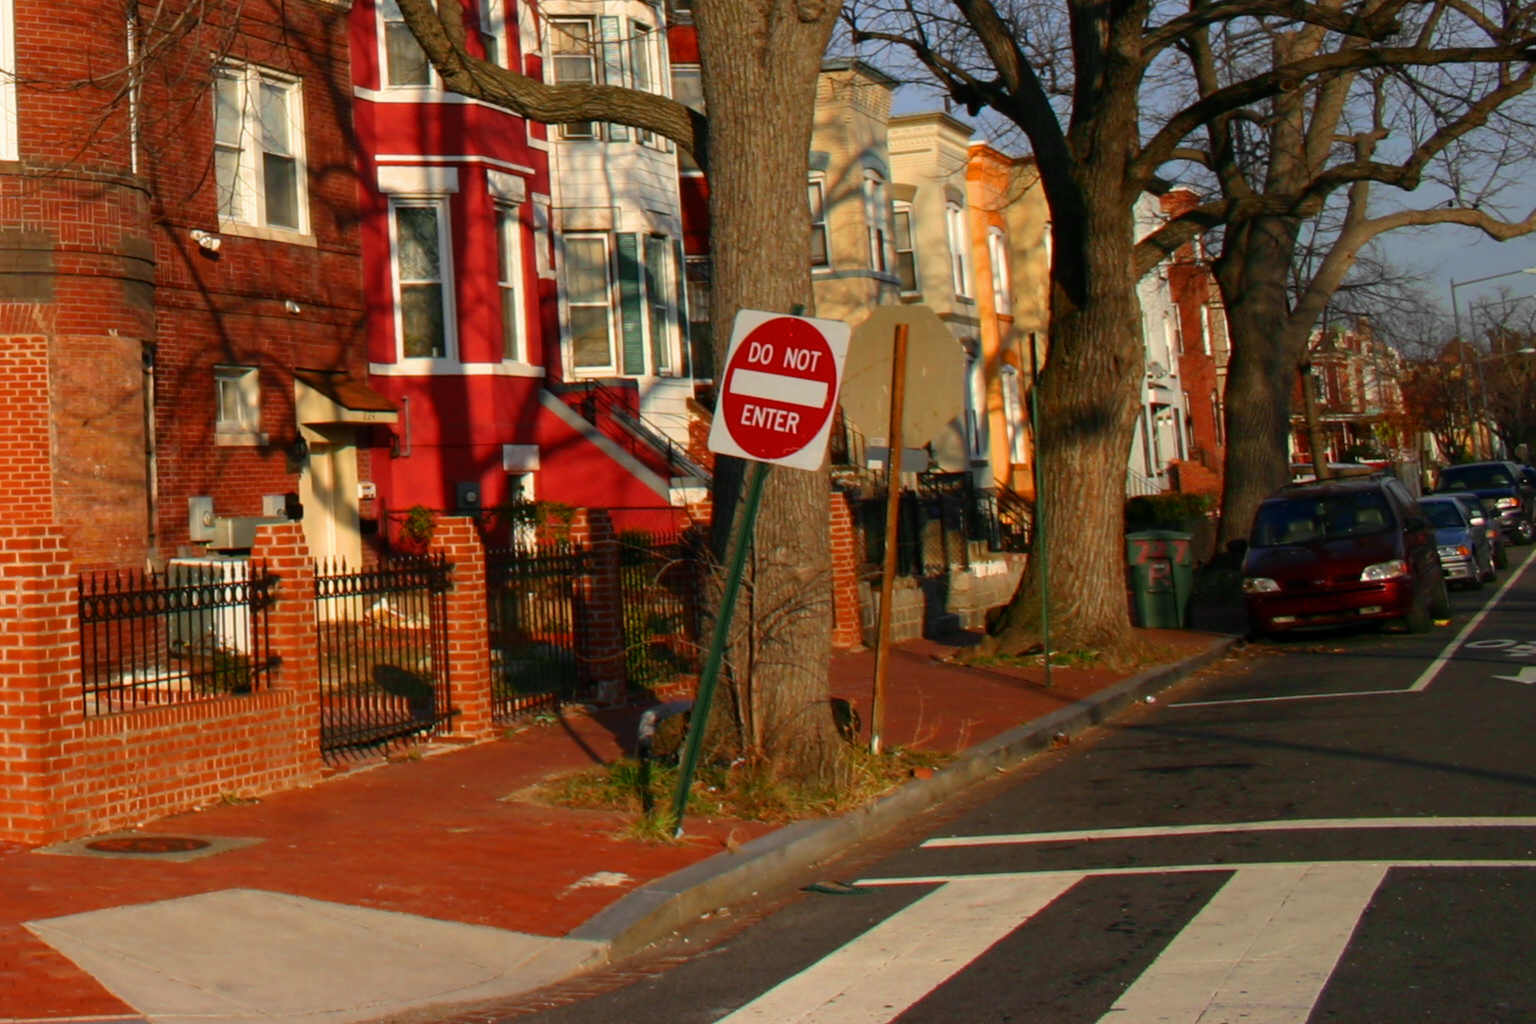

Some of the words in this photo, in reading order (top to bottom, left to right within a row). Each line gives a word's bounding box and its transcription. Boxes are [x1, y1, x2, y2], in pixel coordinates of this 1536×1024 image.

[748, 342, 774, 365] DO
[783, 347, 822, 372] NOT
[740, 404, 800, 434] ENTER
